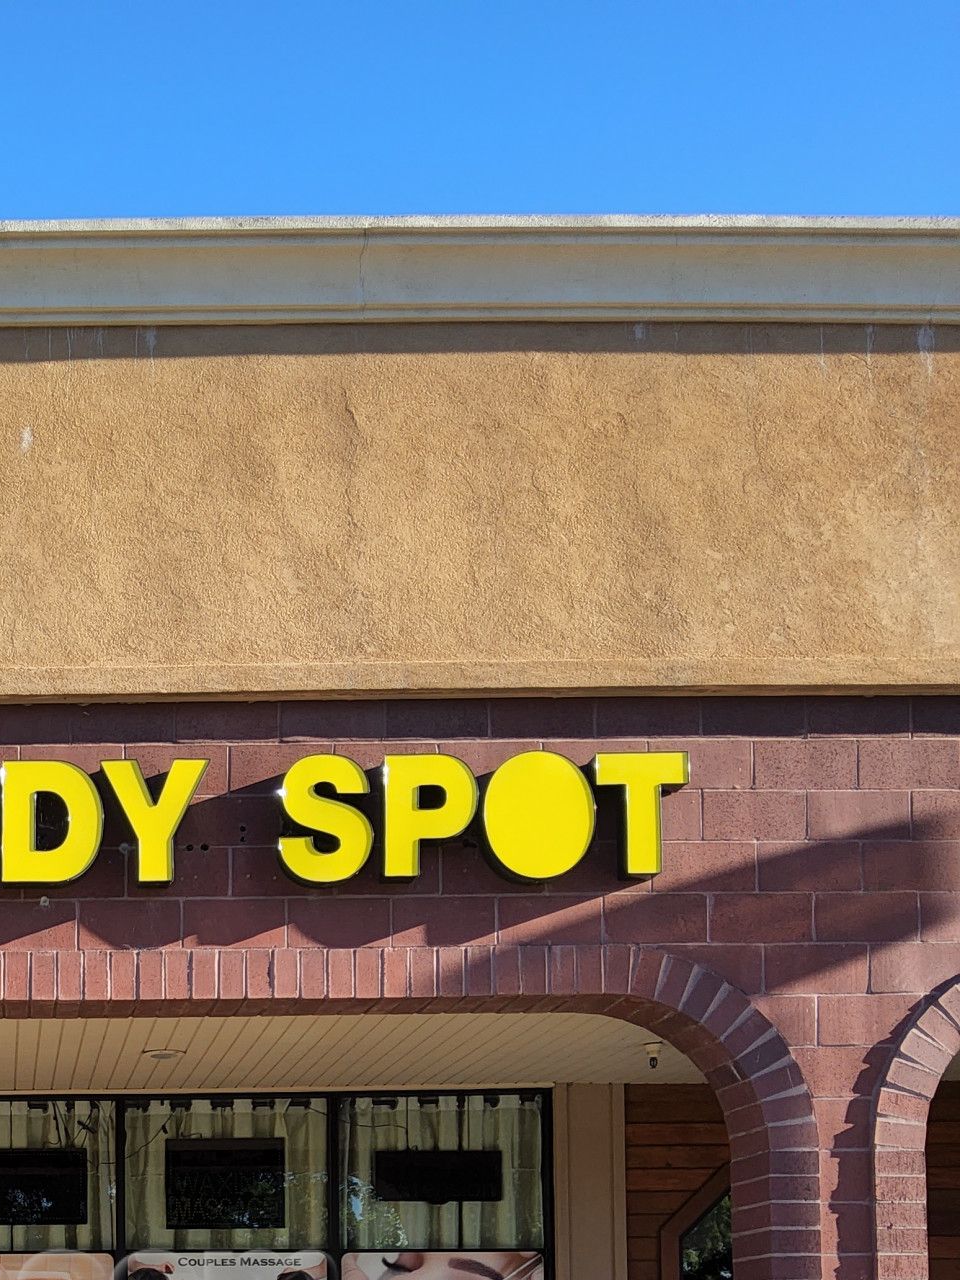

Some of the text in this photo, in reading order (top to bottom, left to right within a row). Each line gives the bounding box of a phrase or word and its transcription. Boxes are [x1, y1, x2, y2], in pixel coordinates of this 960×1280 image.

[280, 750, 690, 882] SPOT
[178, 1257, 301, 1267] COUPLES MASSAGE
